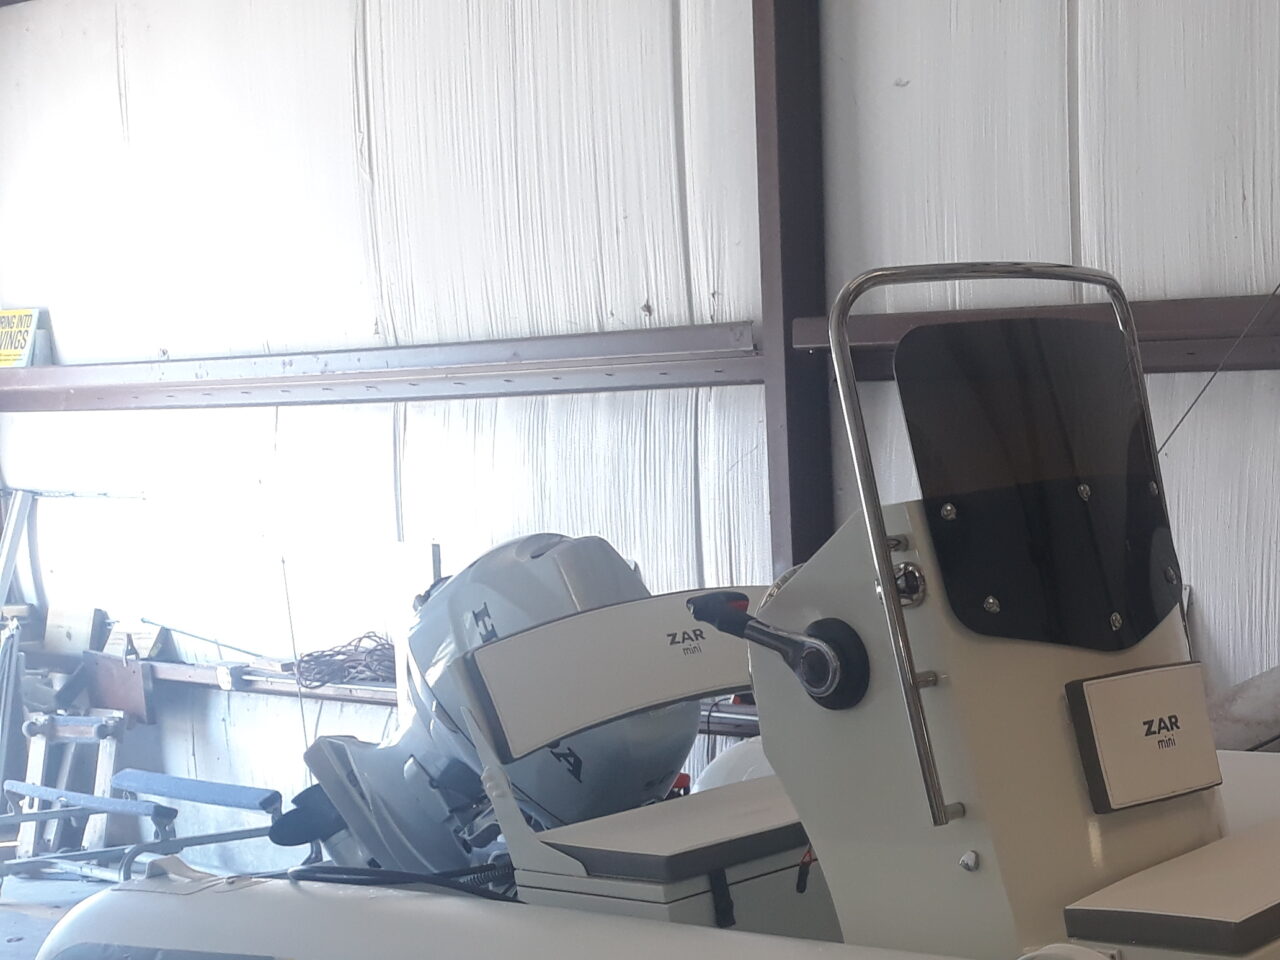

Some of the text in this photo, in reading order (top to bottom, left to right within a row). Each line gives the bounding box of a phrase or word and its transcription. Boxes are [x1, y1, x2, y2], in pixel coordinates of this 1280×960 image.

[16, 314, 33, 329] INTO
[666, 628, 706, 646] ZAR
[683, 644, 703, 656] mini
[1142, 714, 1180, 736] ZAR
[1157, 734, 1176, 750] mini
